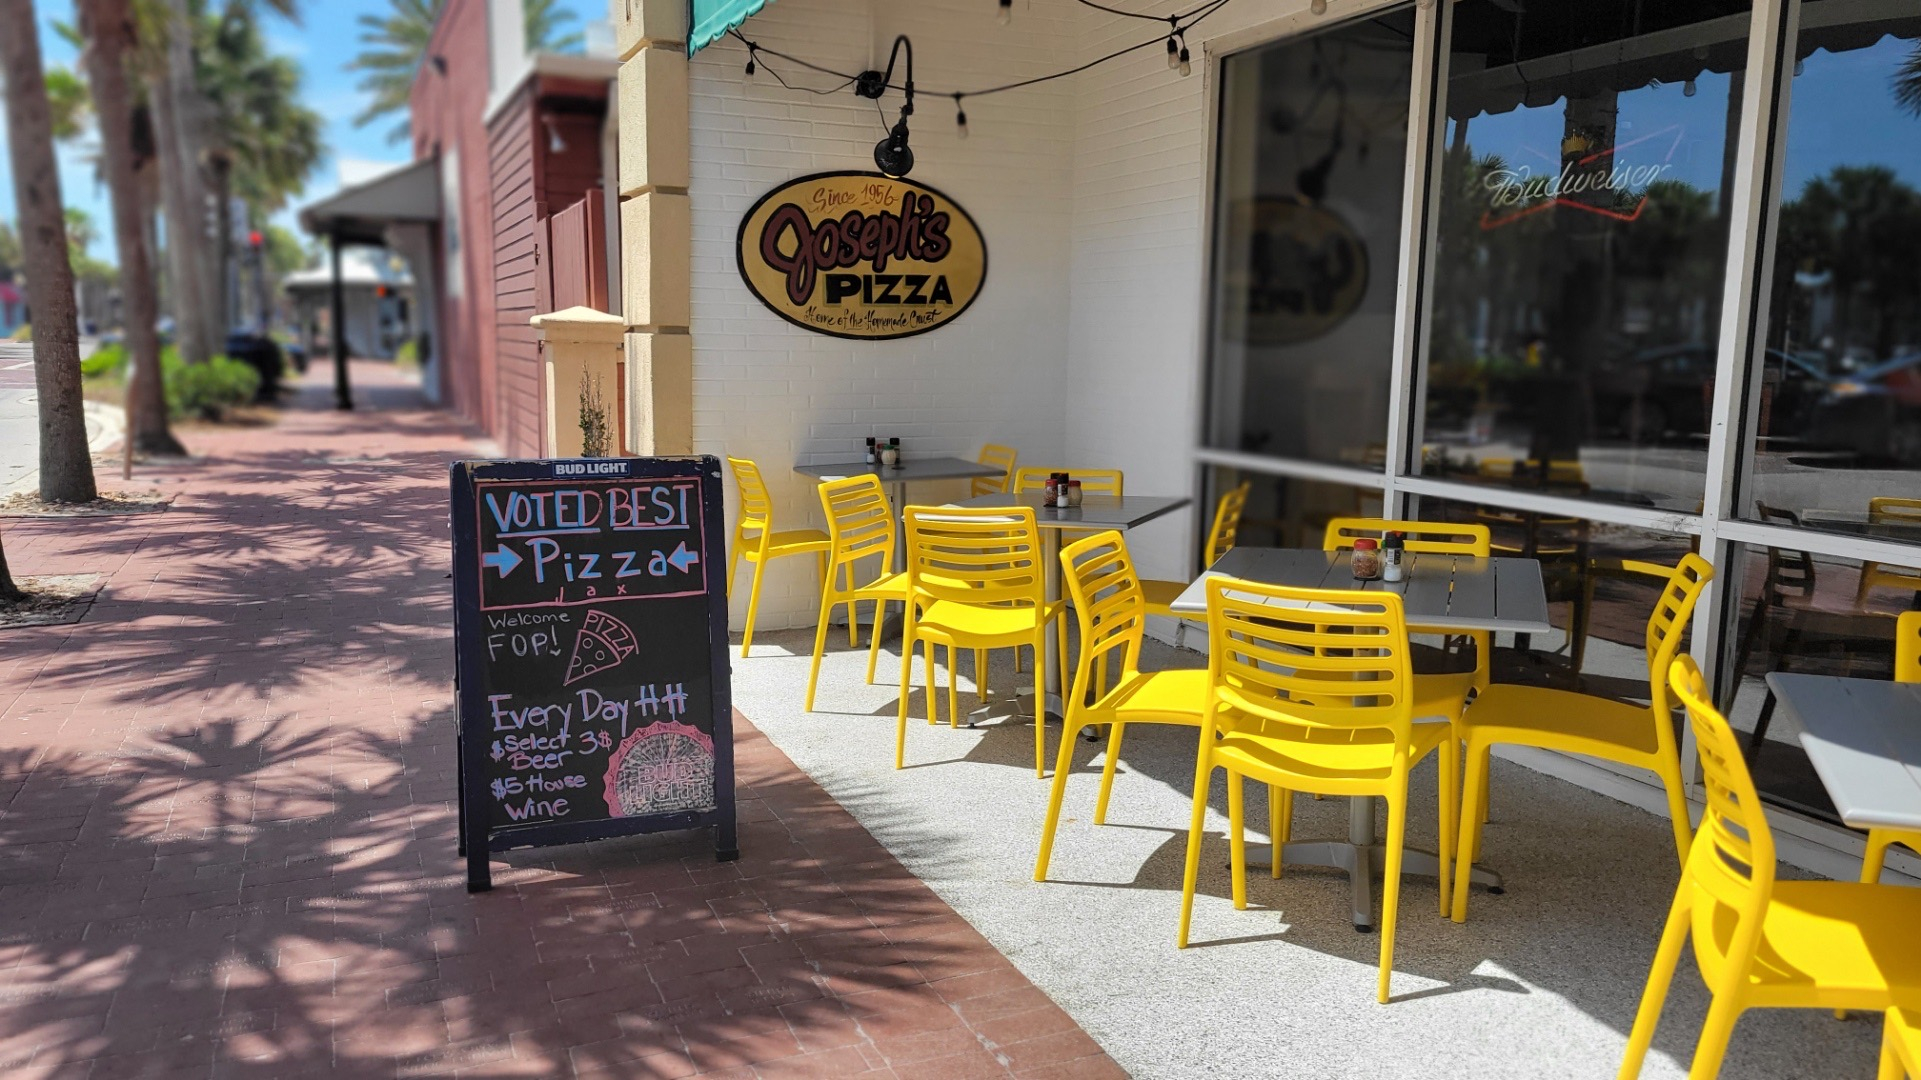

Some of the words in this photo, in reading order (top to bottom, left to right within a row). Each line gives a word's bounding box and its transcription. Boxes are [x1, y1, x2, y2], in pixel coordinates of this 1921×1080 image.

[812, 188, 858, 208] Since
[861, 184, 899, 206] 1956
[1484, 159, 1672, 207] Budweiser
[760, 191, 951, 306] Joseph's
[825, 274, 954, 305] PIZZA
[804, 306, 836, 326] Home
[837, 309, 848, 330] of
[864, 310, 908, 332] Homemade
[909, 309, 942, 328] Crust
[555, 464, 586, 475] BUD
[587, 462, 627, 474] LIGHT
[486, 489, 603, 532] VOTED
[606, 484, 694, 528] BEST
[525, 537, 668, 584] Pizza
[487, 612, 571, 630] Welcome
[583, 613, 635, 660] PIZZA
[488, 693, 573, 738] Every
[575, 687, 629, 737] Day
[507, 750, 573, 771] Beer
[638, 762, 693, 784] BUD
[525, 772, 588, 794] House
[629, 779, 709, 804] LIGHT
